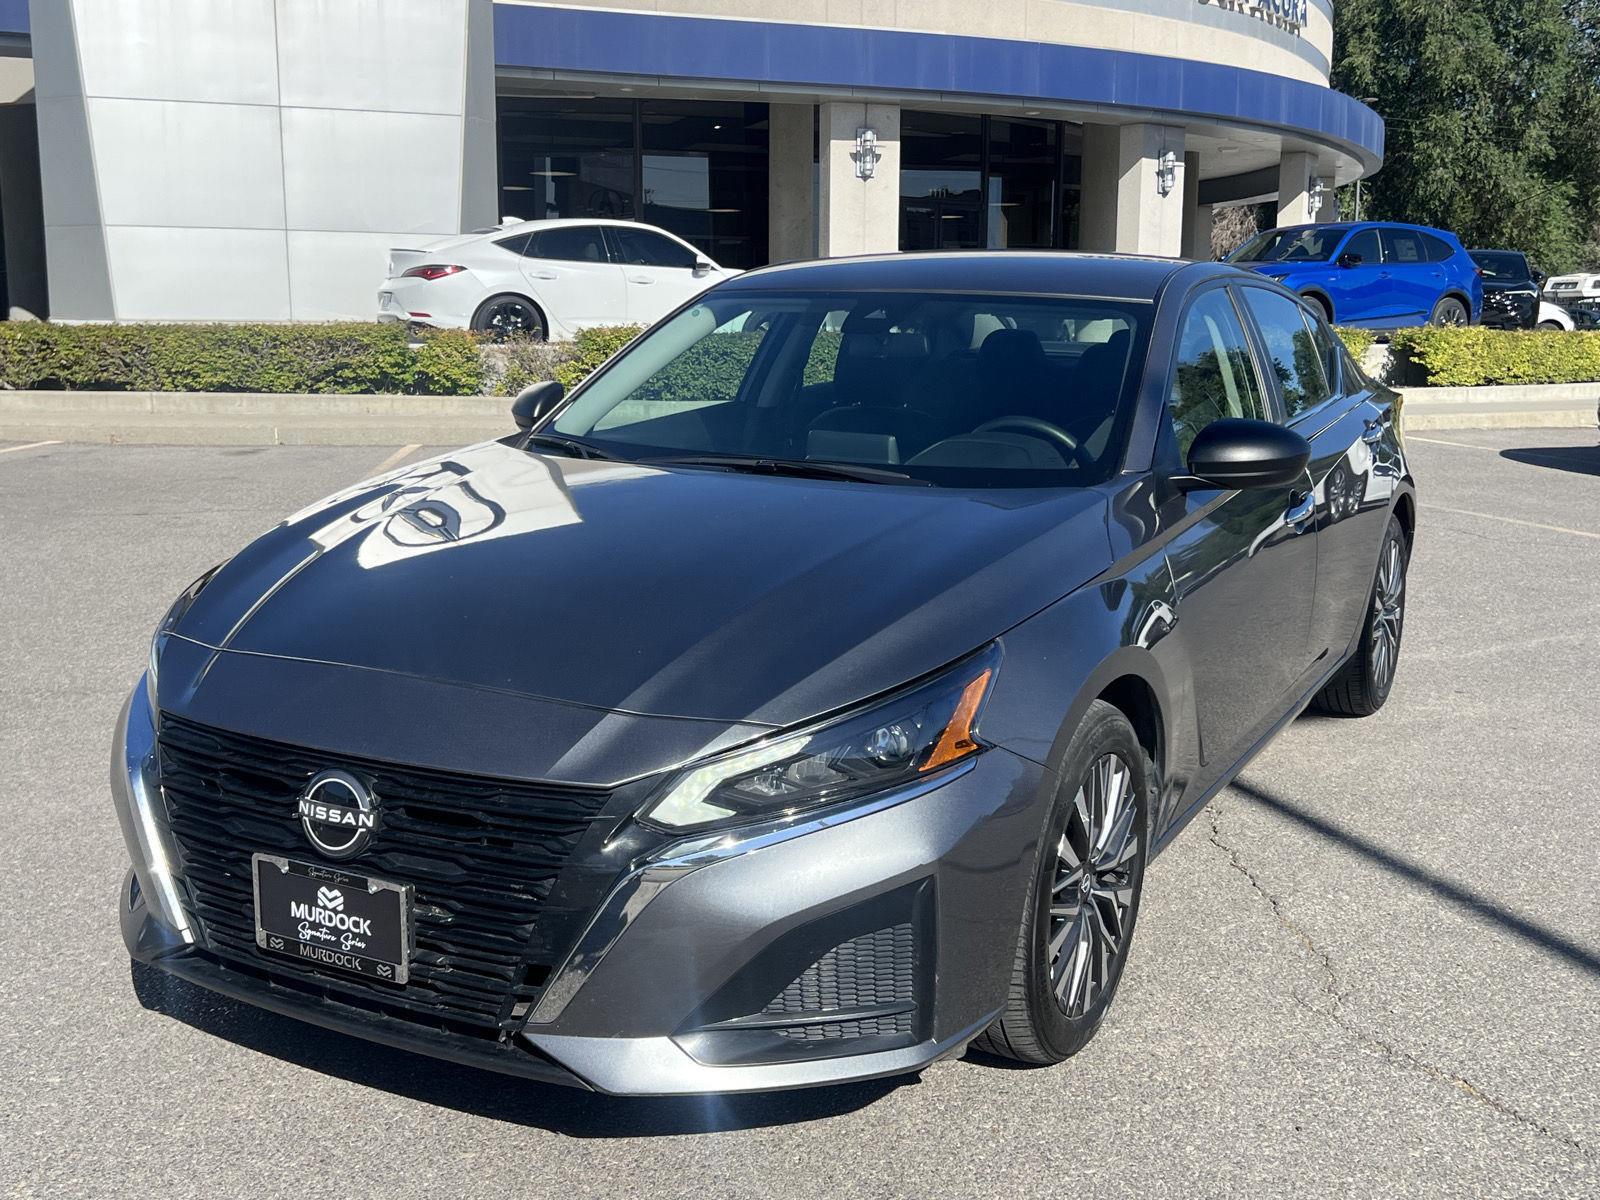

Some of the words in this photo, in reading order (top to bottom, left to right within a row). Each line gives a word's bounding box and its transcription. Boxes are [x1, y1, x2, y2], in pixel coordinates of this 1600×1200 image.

[299, 800, 374, 828] NISSAN
[291, 901, 372, 936] MURDOCK
[298, 921, 337, 941] Signature
[340, 932, 366, 951] Series
[300, 943, 362, 970] MURDOCK
